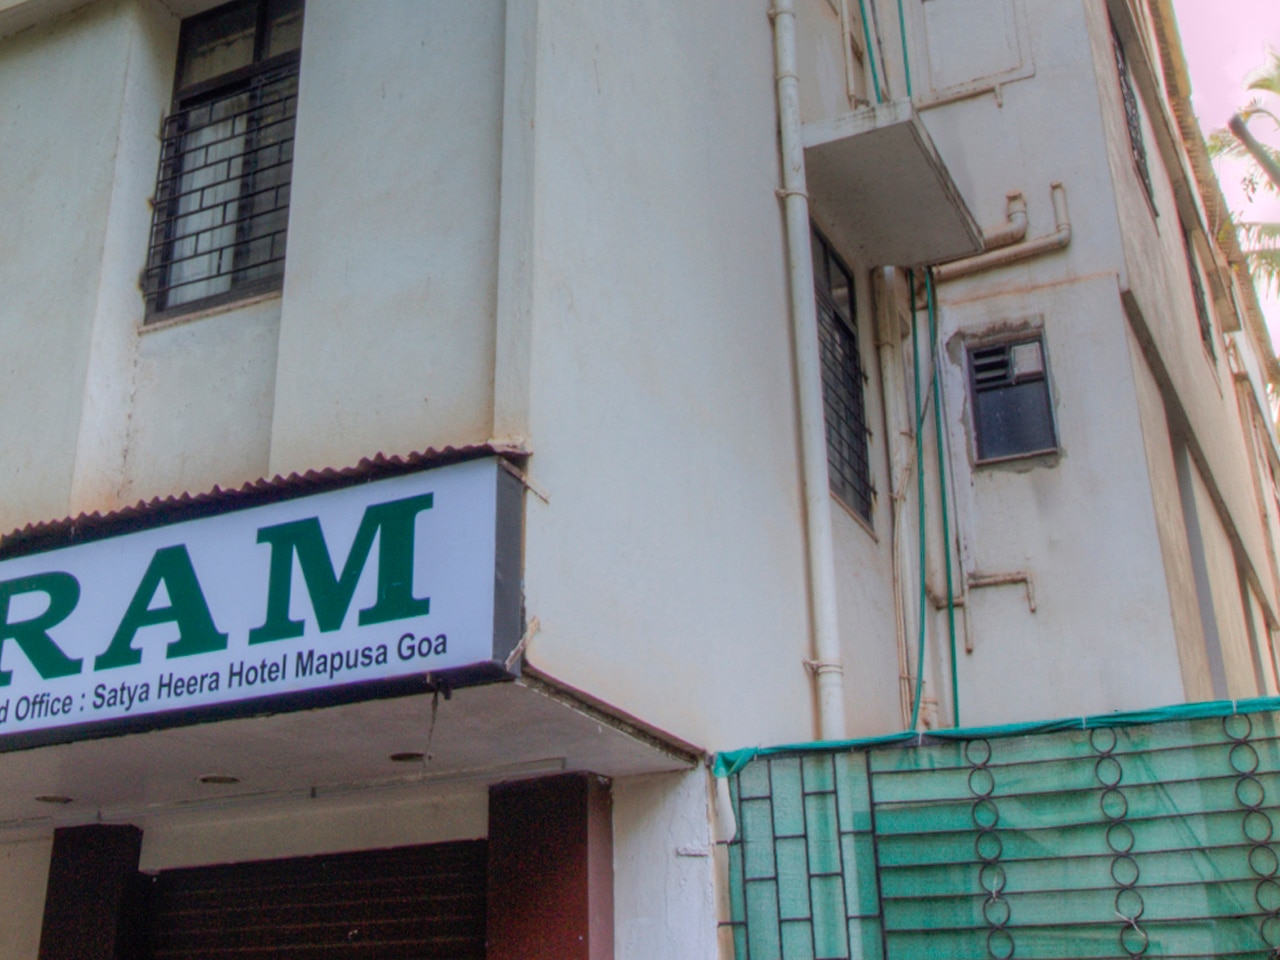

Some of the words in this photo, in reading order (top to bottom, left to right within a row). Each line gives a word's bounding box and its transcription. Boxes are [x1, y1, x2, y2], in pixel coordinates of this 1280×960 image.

[15, 693, 74, 722] Office
[92, 683, 150, 712] Satya
[157, 669, 220, 700] Heera
[227, 654, 287, 689] Hotel
[295, 644, 388, 679] Mapusa
[397, 633, 448, 661] Goa
